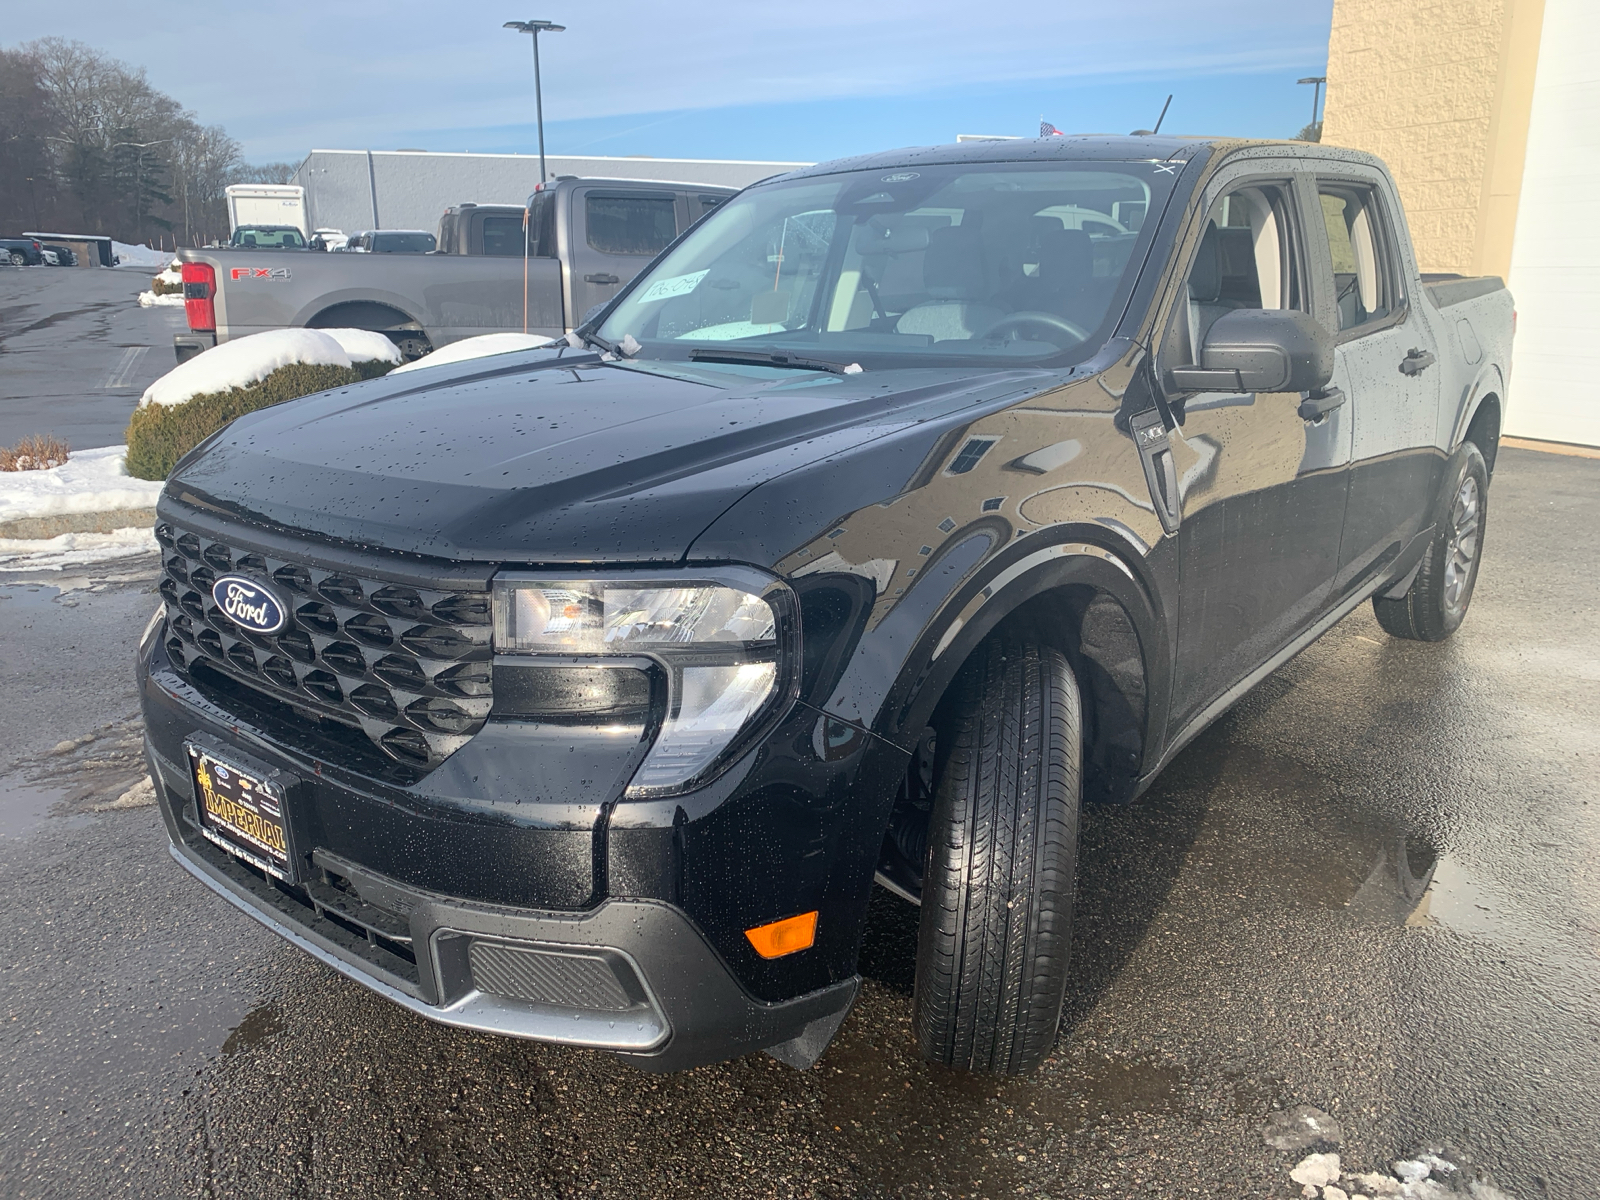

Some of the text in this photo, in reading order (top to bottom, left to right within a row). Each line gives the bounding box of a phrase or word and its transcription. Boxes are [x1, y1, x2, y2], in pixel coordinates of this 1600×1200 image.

[230, 267, 292, 282] FX4
[225, 583, 268, 626] Ford
[203, 787, 287, 853] IMPERIAL
